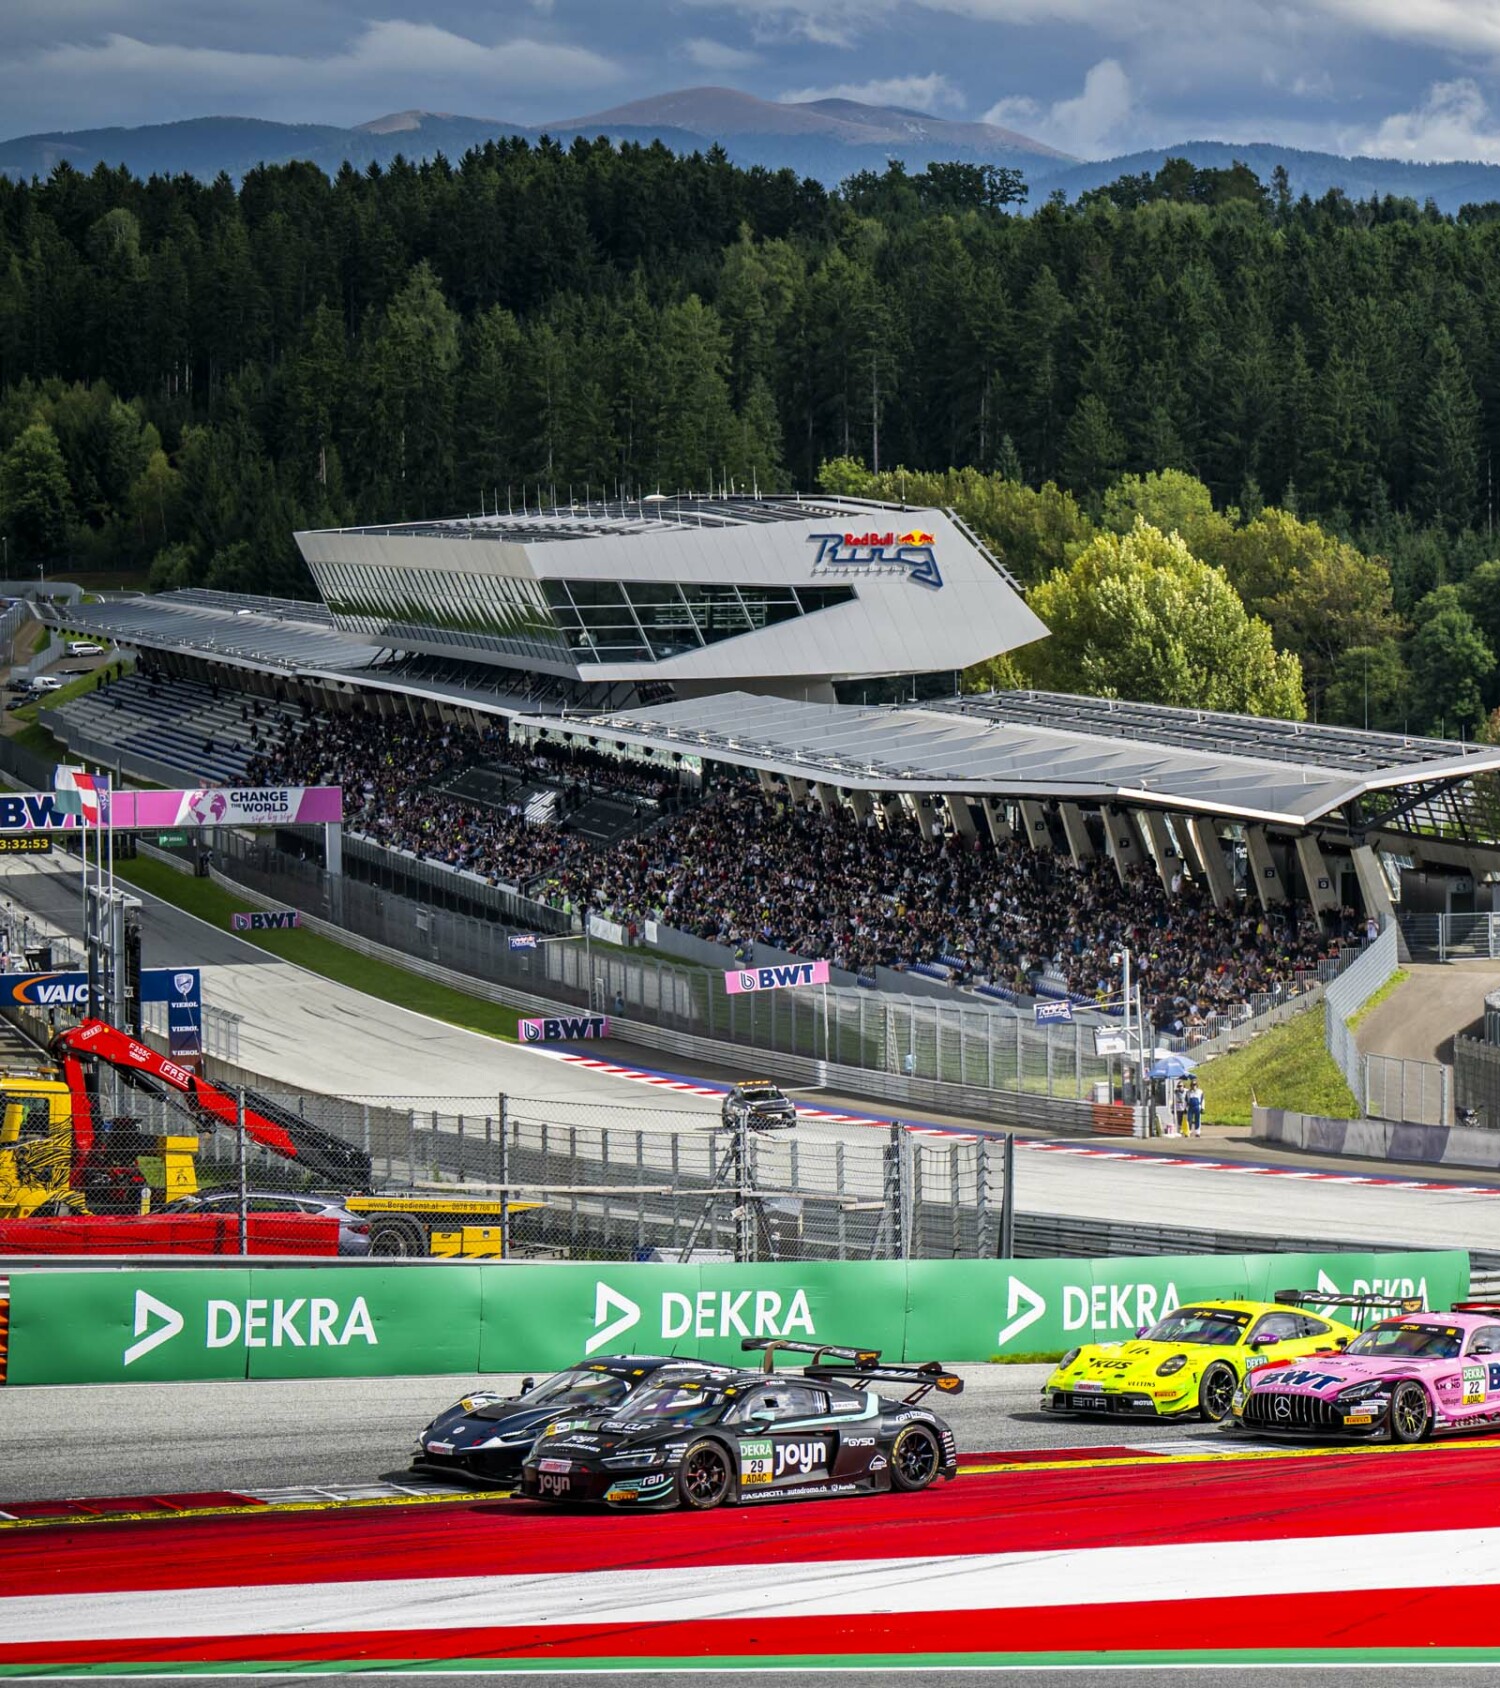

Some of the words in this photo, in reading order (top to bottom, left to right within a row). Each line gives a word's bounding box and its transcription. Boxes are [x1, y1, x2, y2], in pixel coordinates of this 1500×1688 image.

[844, 533, 868, 546] Red
[870, 533, 893, 546] Bull
[806, 534, 943, 588] Ring
[230, 791, 288, 802] CHANGE
[243, 803, 288, 812] WORLD
[251, 912, 296, 928] BWT
[759, 963, 813, 989] BWT
[37, 985, 104, 1003] VAIC
[543, 1018, 604, 1040] BWT
[661, 1288, 815, 1339] DEKRA
[1062, 1281, 1181, 1331] DEKRA
[207, 1296, 378, 1348] DEKRA
[1256, 1370, 1341, 1391] BWT
[1464, 1368, 1485, 1379] DEKRA
[1469, 1381, 1480, 1394] 22
[741, 1444, 772, 1457] DEKRA
[750, 1460, 764, 1473] 29
[775, 1442, 827, 1476] joyn
[538, 1474, 571, 1496] joyn
[642, 1474, 665, 1486] ran
[745, 1473, 767, 1484] ADAC
[787, 1485, 828, 1496] autodromo.ch
